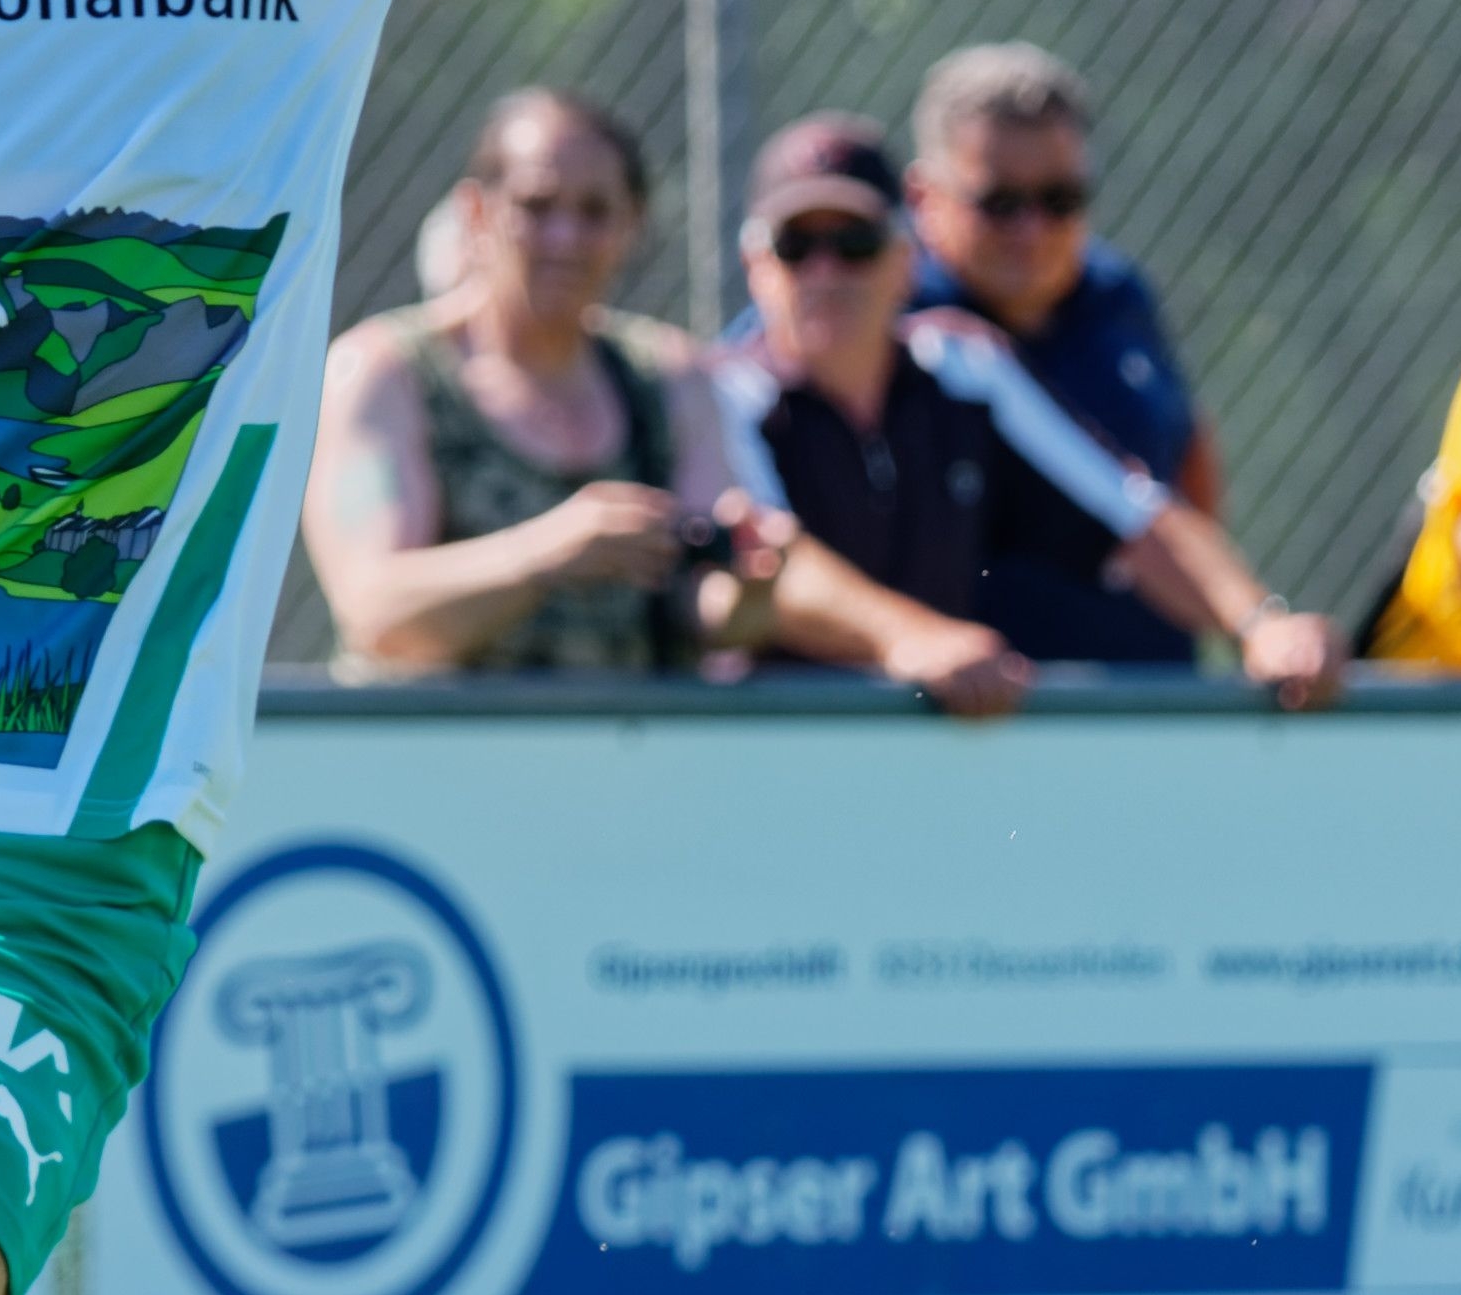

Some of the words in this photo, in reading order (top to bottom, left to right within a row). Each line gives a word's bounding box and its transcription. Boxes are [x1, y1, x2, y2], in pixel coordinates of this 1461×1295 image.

[576, 1131, 878, 1272] Gipser
[880, 1129, 1039, 1242] Art
[1044, 1122, 1331, 1241] GmbH
